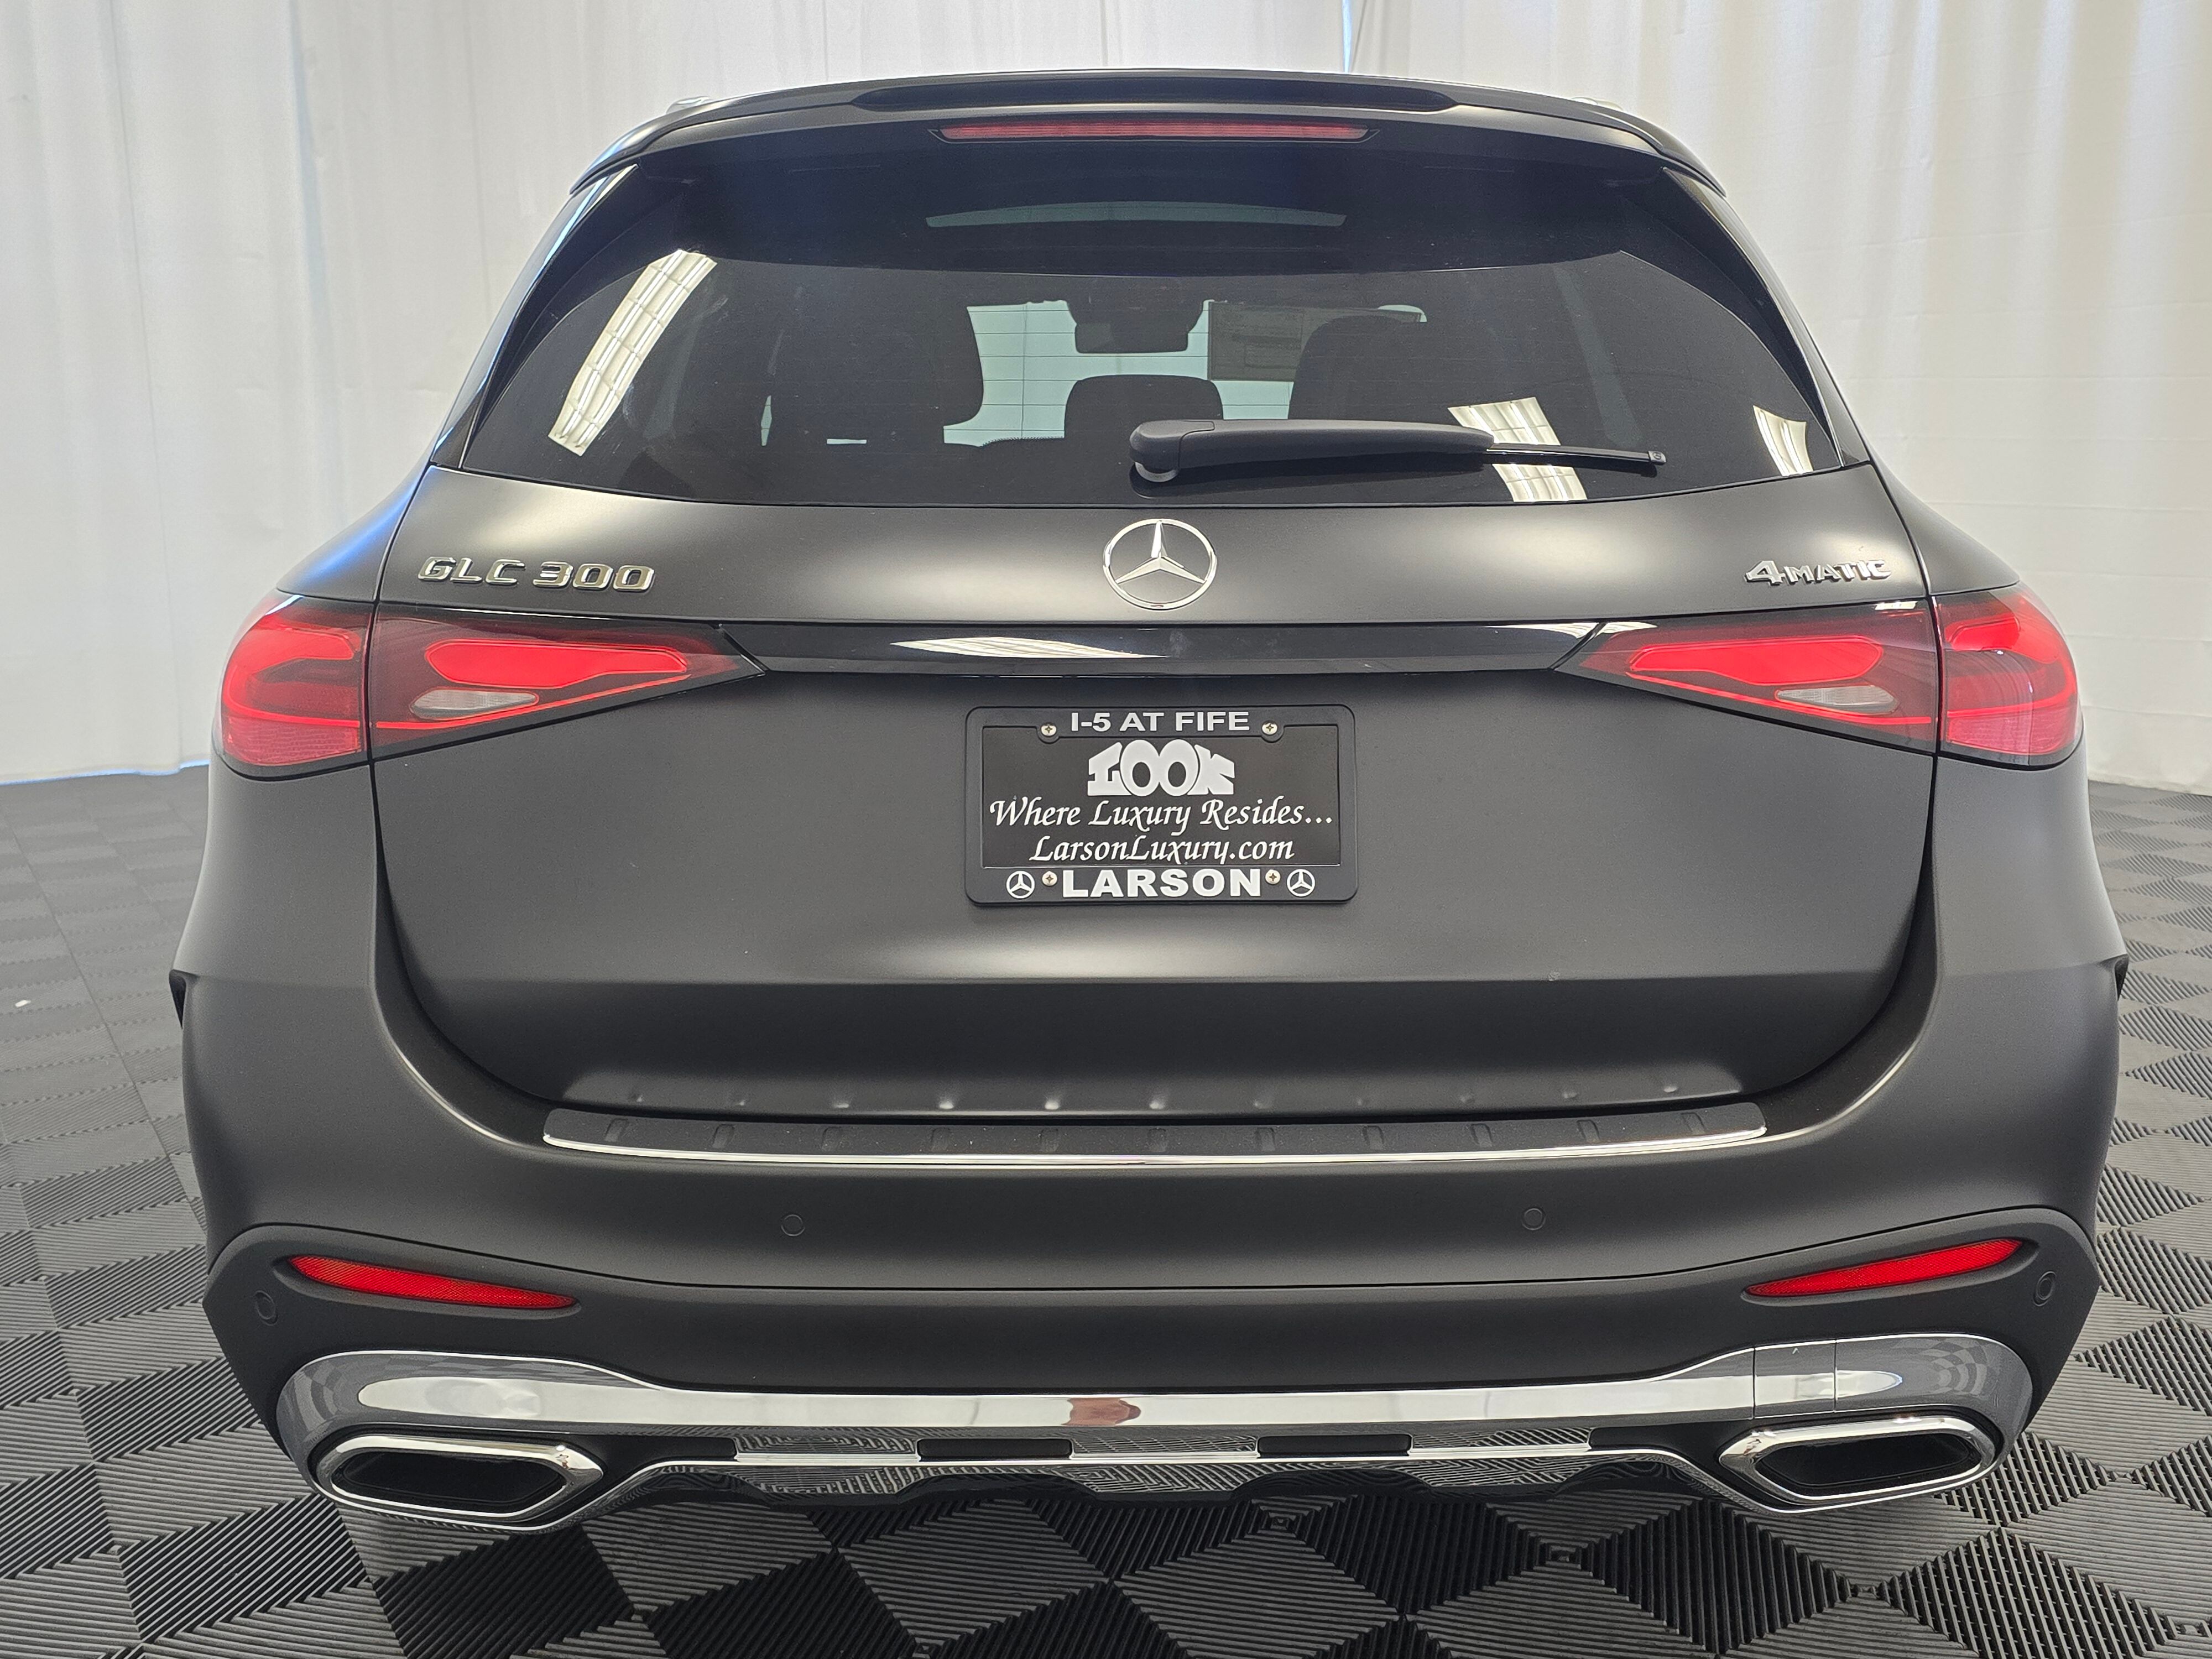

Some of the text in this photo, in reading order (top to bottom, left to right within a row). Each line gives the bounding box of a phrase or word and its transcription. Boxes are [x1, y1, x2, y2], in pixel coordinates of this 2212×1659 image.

[418, 556, 655, 592] GLC 300
[1744, 560, 1892, 586] 4MATIC
[1071, 711, 1250, 732] I-5 AT FIFE
[1087, 739, 1235, 797] LOOK
[989, 795, 1333, 837] Where Luxury Resides...
[1029, 834, 1295, 865] LarsonLuxury.com
[1062, 869, 1261, 898] LARSON
